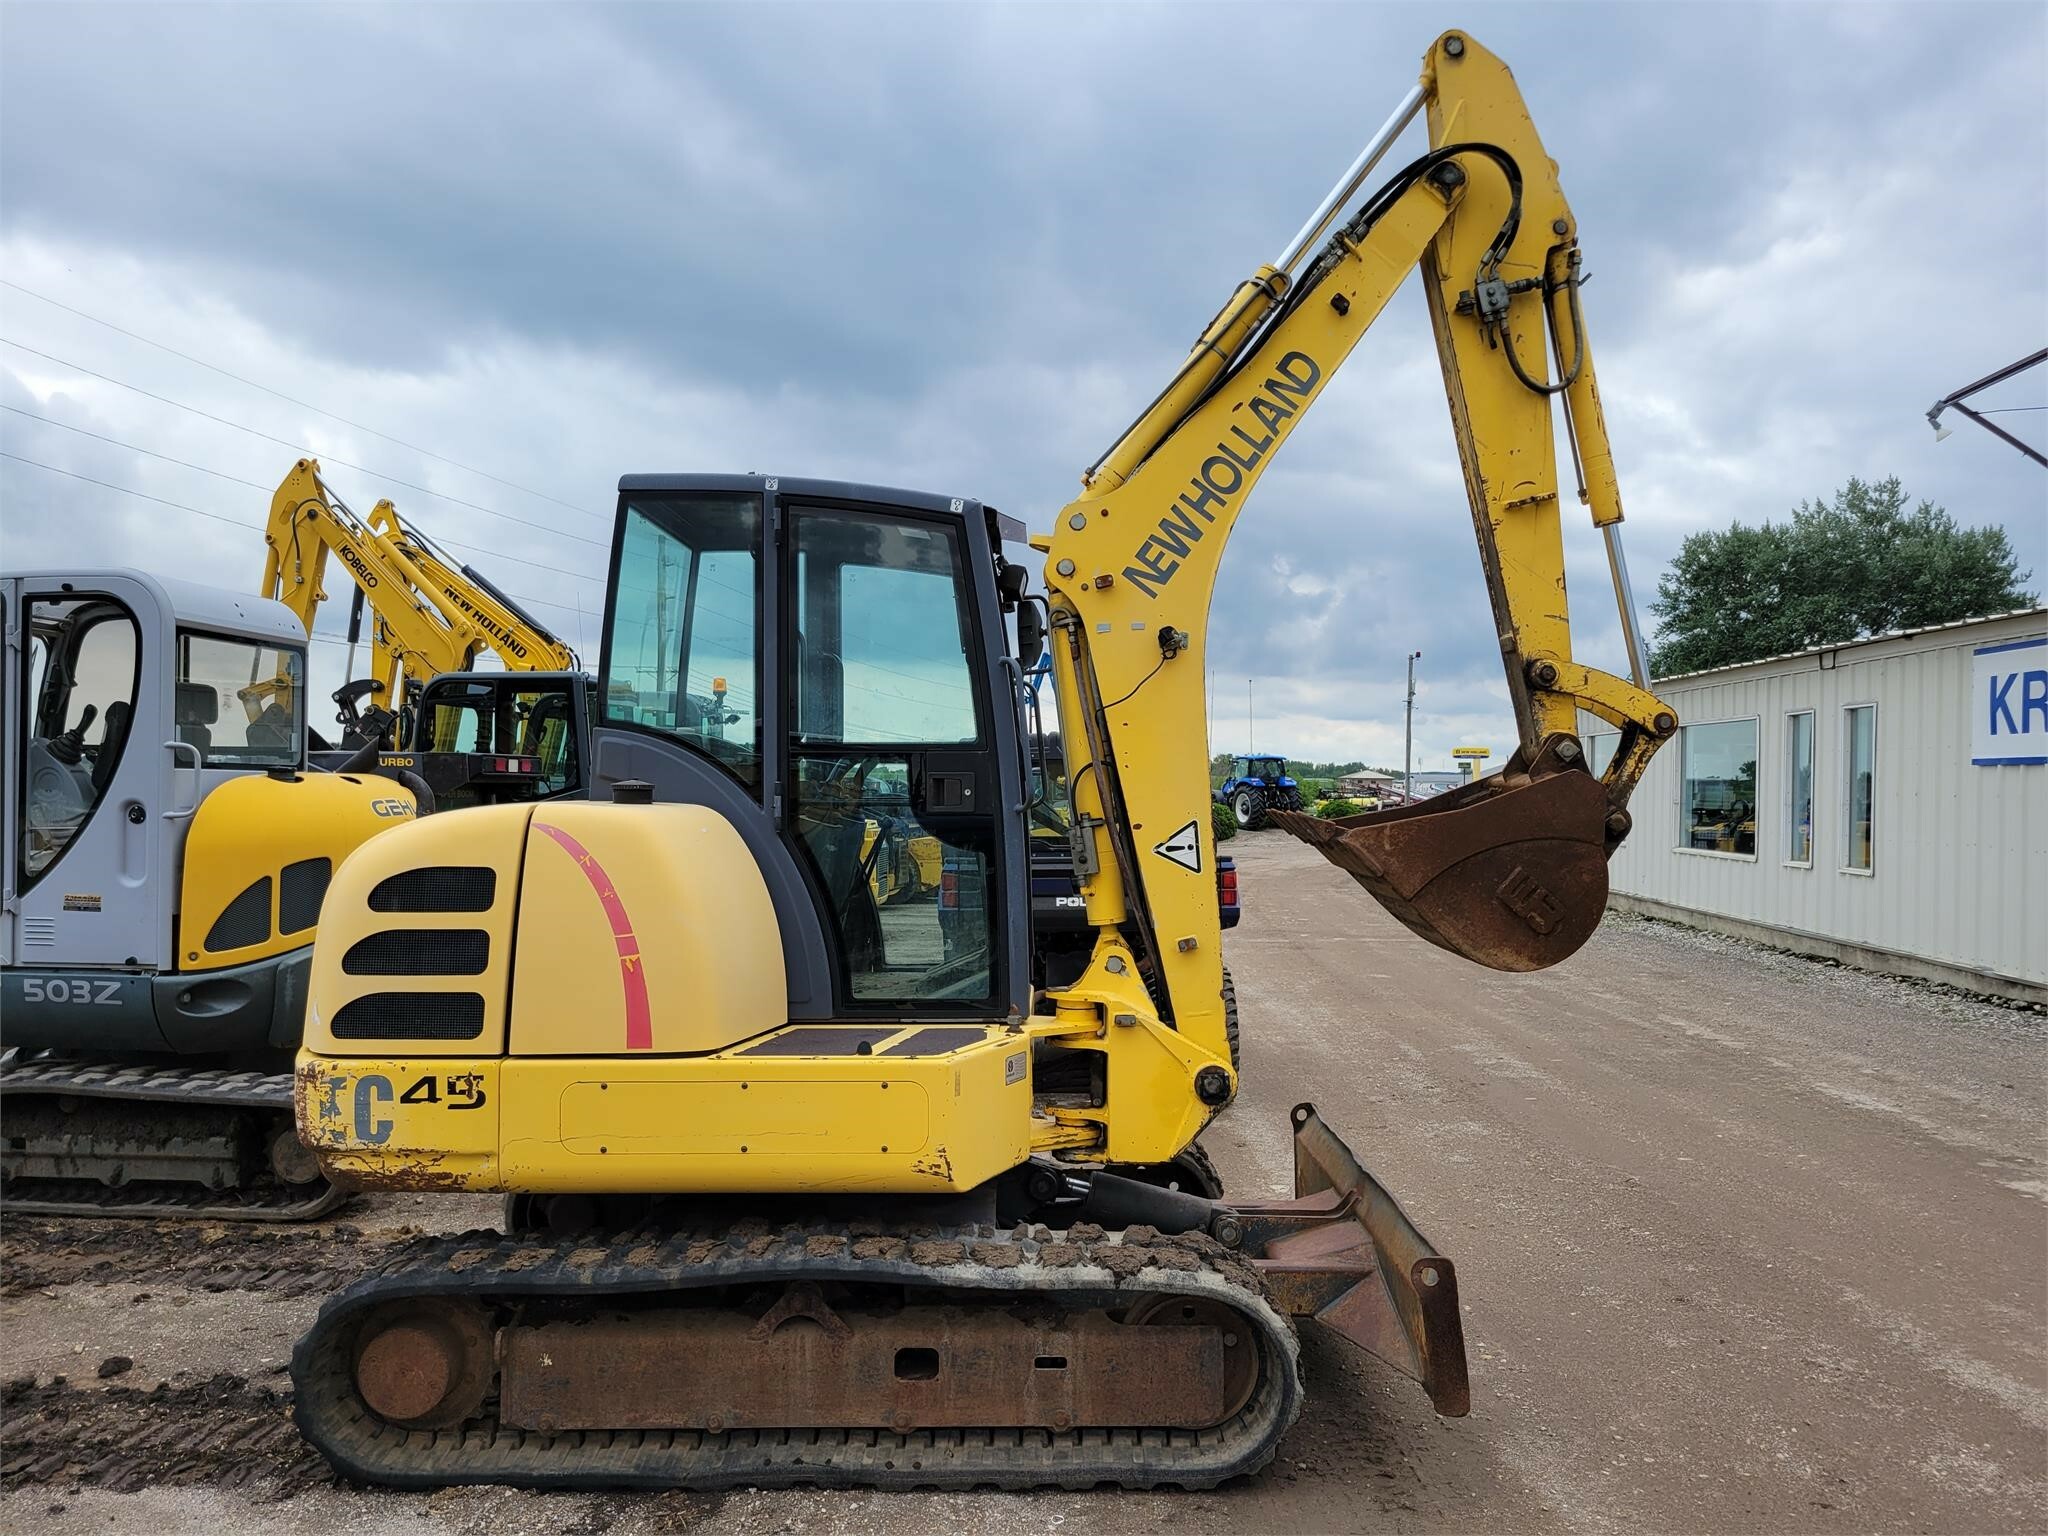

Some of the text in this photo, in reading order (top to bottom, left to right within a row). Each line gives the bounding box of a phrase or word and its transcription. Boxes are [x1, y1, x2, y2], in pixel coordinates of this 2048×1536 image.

[1121, 351, 1321, 599] NEW HOLLAND
[339, 545, 378, 589] KOBELCO
[444, 585, 528, 659] NEW HOLLAND
[379, 757, 414, 767] URBO
[372, 799, 416, 817] GEH
[24, 978, 122, 1005] 503Z
